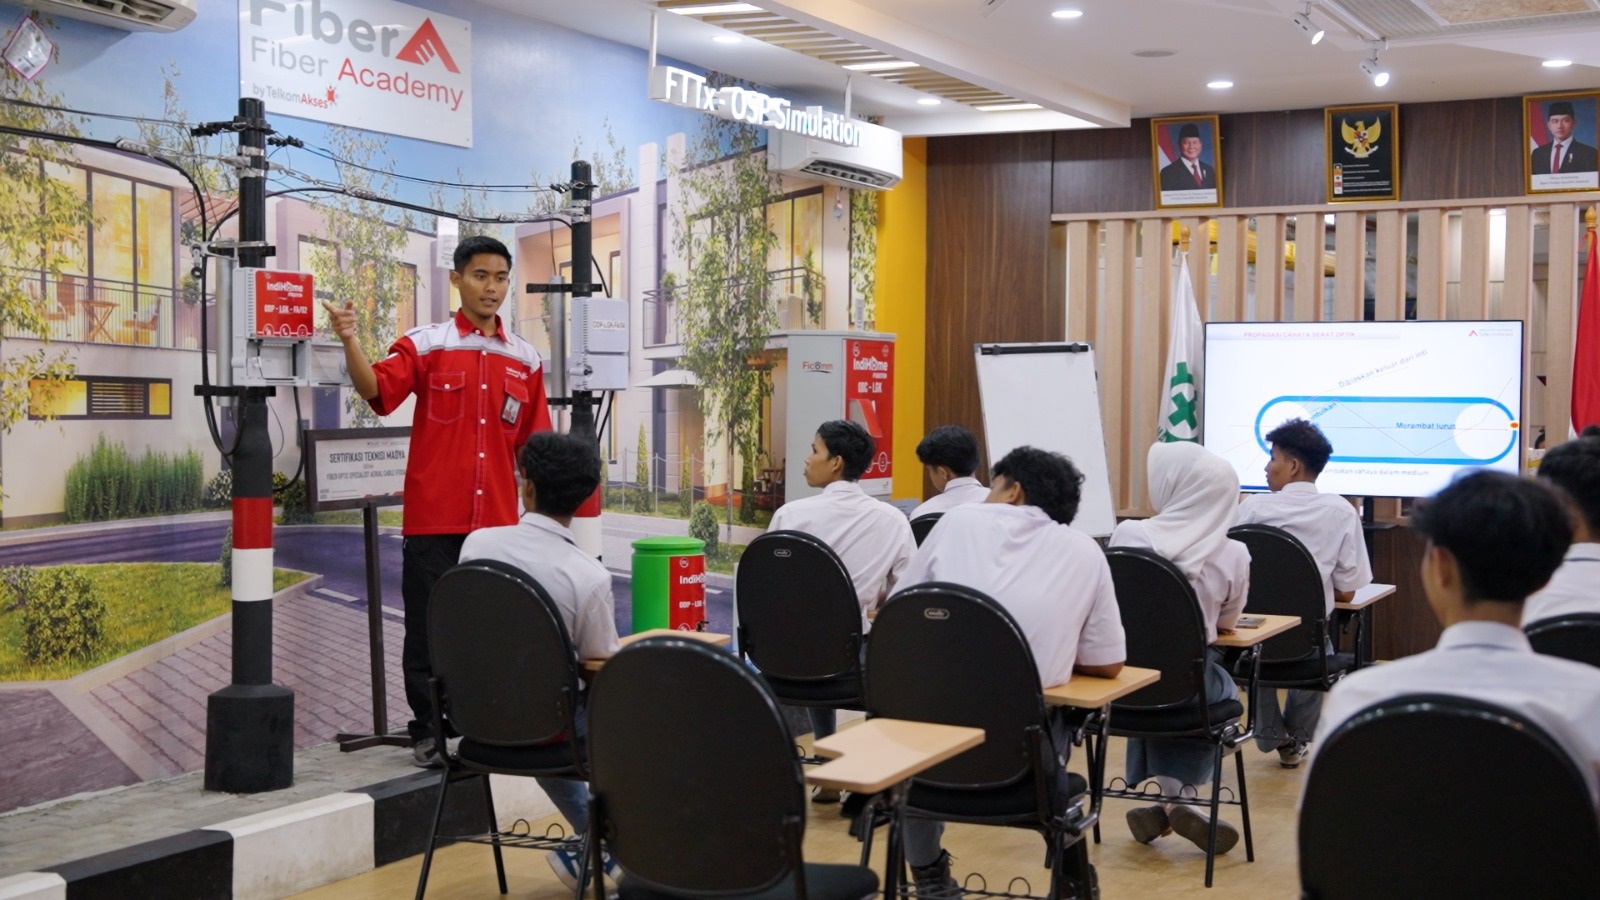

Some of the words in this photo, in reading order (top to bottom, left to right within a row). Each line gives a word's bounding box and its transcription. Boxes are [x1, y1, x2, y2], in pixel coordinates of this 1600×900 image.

[251, 36, 328, 76] Fiber
[252, 83, 265, 98] by
[338, 58, 463, 111] Academy
[731, 87, 774, 125] OSP
[774, 100, 863, 147] Simulation
[853, 356, 888, 371] IndiHome
[1400, 353, 1414, 364] dari
[1396, 421, 1434, 429] Merambat
[329, 451, 363, 463] SERTIFIKASI
[364, 450, 386, 461] TEKNISI
[387, 450, 405, 460] MADYA
